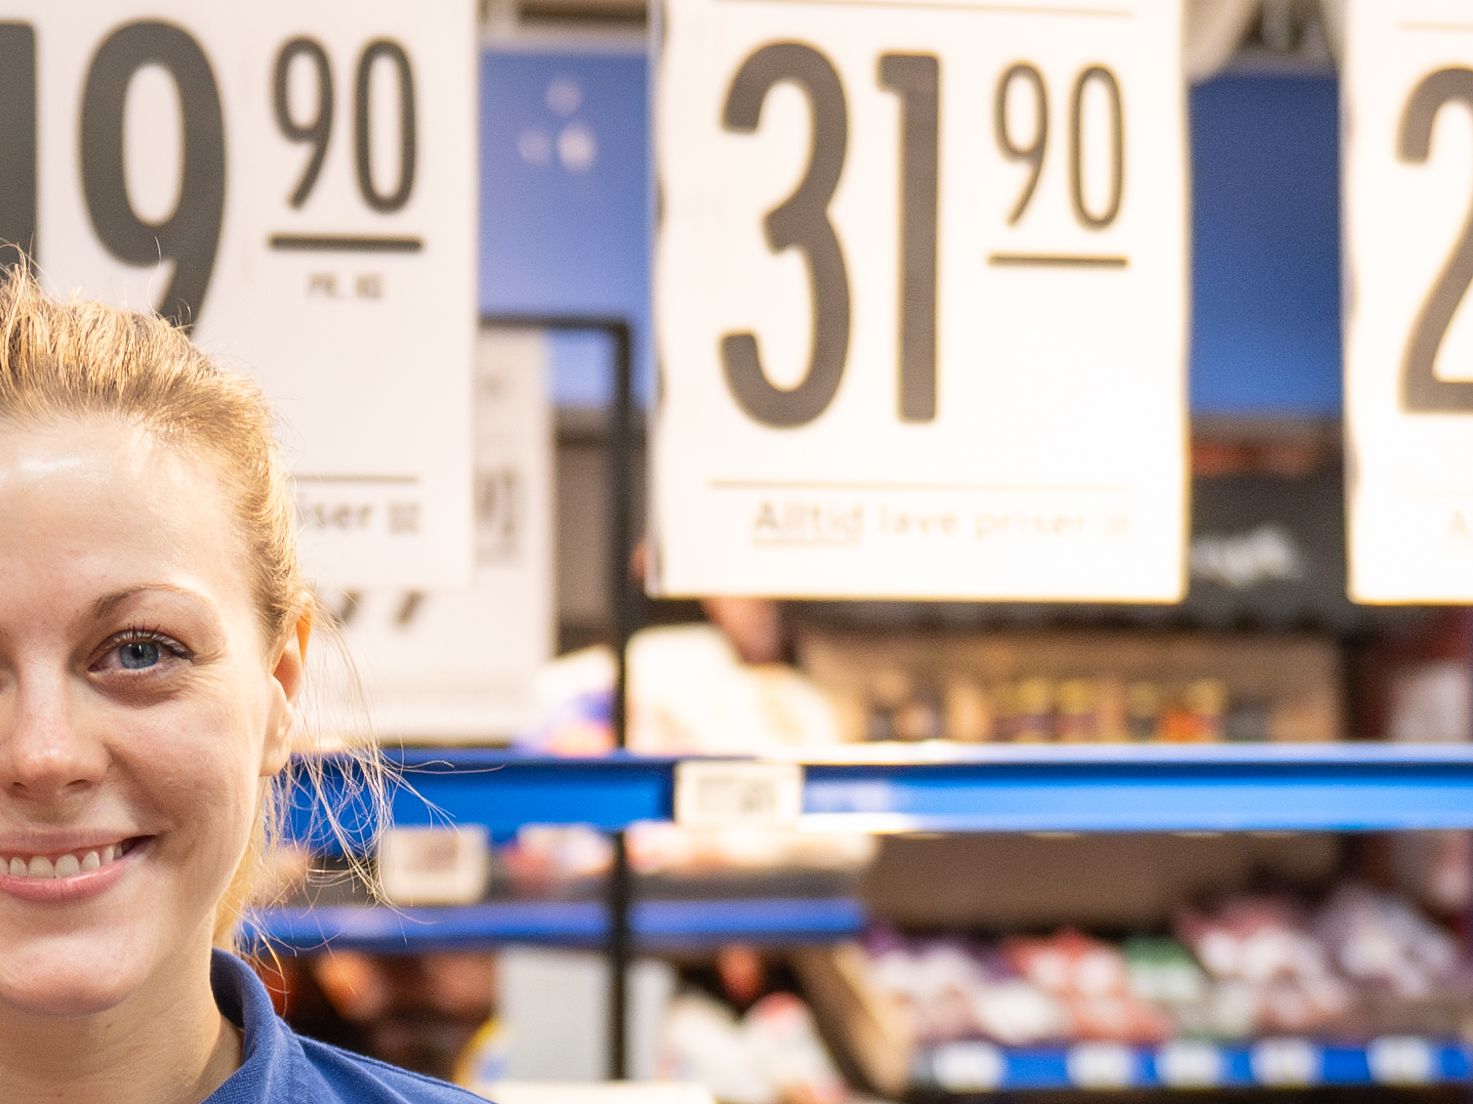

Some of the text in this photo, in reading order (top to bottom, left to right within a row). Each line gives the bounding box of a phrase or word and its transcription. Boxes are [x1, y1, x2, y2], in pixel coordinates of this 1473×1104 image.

[272, 36, 418, 213] 90
[719, 40, 1125, 429] 31 90
[1397, 64, 1473, 415] 2
